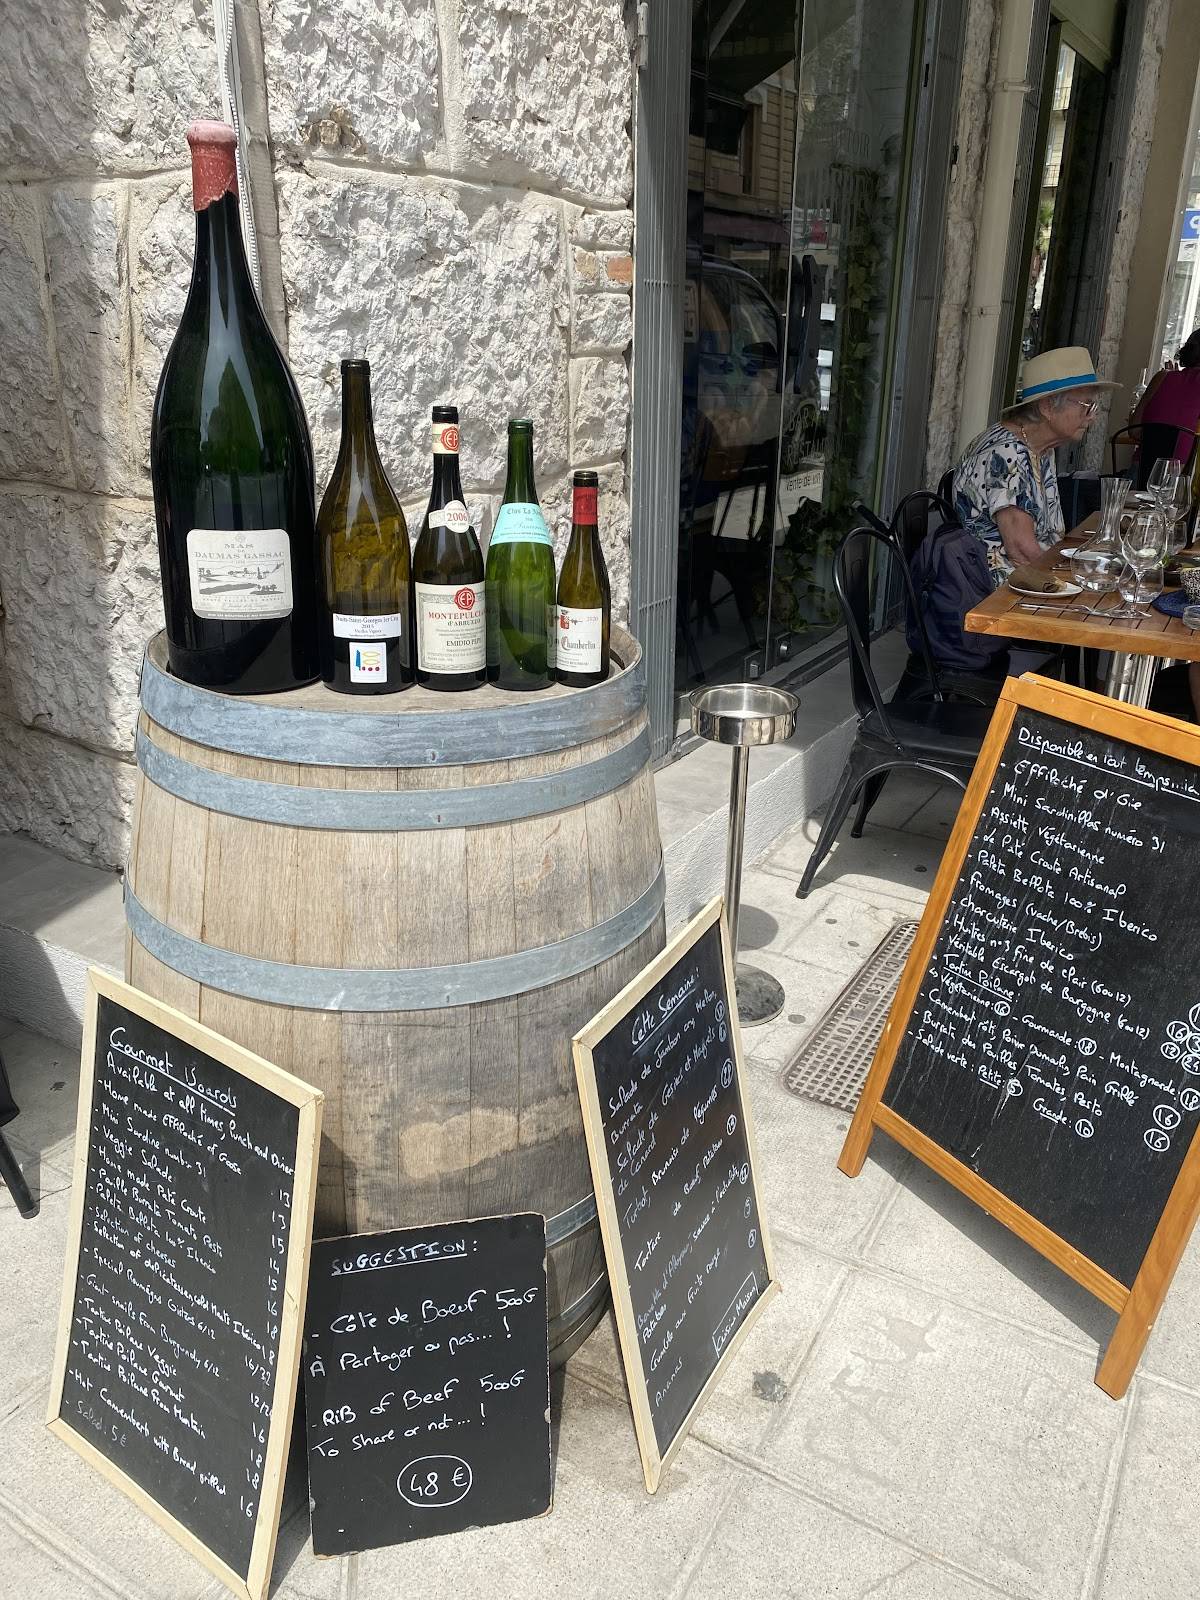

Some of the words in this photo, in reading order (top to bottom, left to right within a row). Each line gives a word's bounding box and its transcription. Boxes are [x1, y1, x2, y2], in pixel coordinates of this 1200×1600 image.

[194, 552, 240, 560] DAUMAS
[244, 551, 285, 559] GASSAC
[1018, 726, 1085, 759] Disponible
[1004, 782, 1027, 807] Mini
[990, 806, 1029, 834] Assiette
[978, 849, 1006, 876] Paleta
[1064, 892, 1097, 913] 100%
[1102, 908, 1158, 942] Iberico
[1069, 866, 1127, 899] Artisanal
[948, 934, 985, 962] Véritable
[1040, 980, 1054, 994] de
[1026, 928, 1074, 962] Iberico
[1040, 960, 1055, 974] de
[866, 960, 900, 996] CABLES
[855, 996, 872, 1010] DE
[110, 1027, 174, 1074] Gourmet
[632, 1010, 656, 1046] Cette
[830, 1016, 862, 1046] LYON
[917, 1028, 945, 1055] Salade
[609, 1080, 638, 1118] Salade
[641, 1064, 652, 1080] de
[655, 1032, 681, 1068] Jambon
[1076, 1065, 1097, 1087] Pain
[107, 1051, 158, 1093] Available
[164, 1086, 176, 1103] at
[180, 1096, 196, 1116] all
[254, 1146, 268, 1161] and
[611, 1102, 644, 1145] Burrata
[617, 1132, 646, 1173] Salade
[648, 1111, 658, 1132] de
[684, 1054, 692, 1072] et
[1074, 1091, 1103, 1117] Pesto
[104, 1080, 130, 1106] Home
[134, 1102, 158, 1122] made
[219, 1152, 242, 1176] Goose
[280, 1189, 292, 1210] 13
[681, 1127, 690, 1146] de
[102, 1103, 120, 1126] Mini
[127, 1117, 161, 1151] Sardine
[272, 1210, 286, 1231] 13
[618, 1178, 629, 1196] de
[630, 1139, 657, 1177] Canard
[98, 1146, 122, 1173] Home
[127, 1170, 151, 1193] made
[269, 1256, 281, 1276] 14
[102, 1126, 133, 1162] Veggie
[272, 1234, 285, 1256] 15
[96, 1183, 123, 1213] Paleta
[268, 1300, 278, 1317] 16
[634, 1232, 662, 1272] Tartare
[672, 1200, 682, 1217] de
[93, 1220, 126, 1251] Selection
[262, 1344, 276, 1366] 18
[93, 1248, 124, 1273] Special
[197, 1321, 216, 1340] 6/12
[96, 1206, 130, 1237] Selection
[146, 1240, 177, 1269] cheeses
[266, 1321, 278, 1340] 18
[268, 1275, 278, 1292] 15
[86, 1274, 109, 1297] Giant
[111, 1294, 137, 1321] snails
[160, 1323, 202, 1370] Burgundy
[330, 1310, 377, 1334] Côte
[388, 1306, 410, 1326] de
[736, 1286, 756, 1317] Maison
[84, 1296, 112, 1325] Tartine
[147, 1345, 178, 1377] Veggie
[252, 1421, 265, 1444] 16
[310, 1354, 326, 1379] À
[340, 1341, 415, 1372] Partager
[424, 1342, 441, 1352] ou
[655, 1356, 683, 1408] Ananas
[82, 1316, 114, 1353] Tartine
[251, 1448, 262, 1469] 18
[80, 1340, 112, 1373] Tartine
[246, 1467, 260, 1491] 18
[74, 1372, 93, 1393] Hot
[100, 1388, 150, 1437] Camembert
[152, 1433, 170, 1456] with
[172, 1447, 197, 1476] Bread
[240, 1496, 253, 1518] 16
[311, 1437, 340, 1458] To
[403, 1426, 421, 1438] or
[410, 1472, 439, 1498] 48
